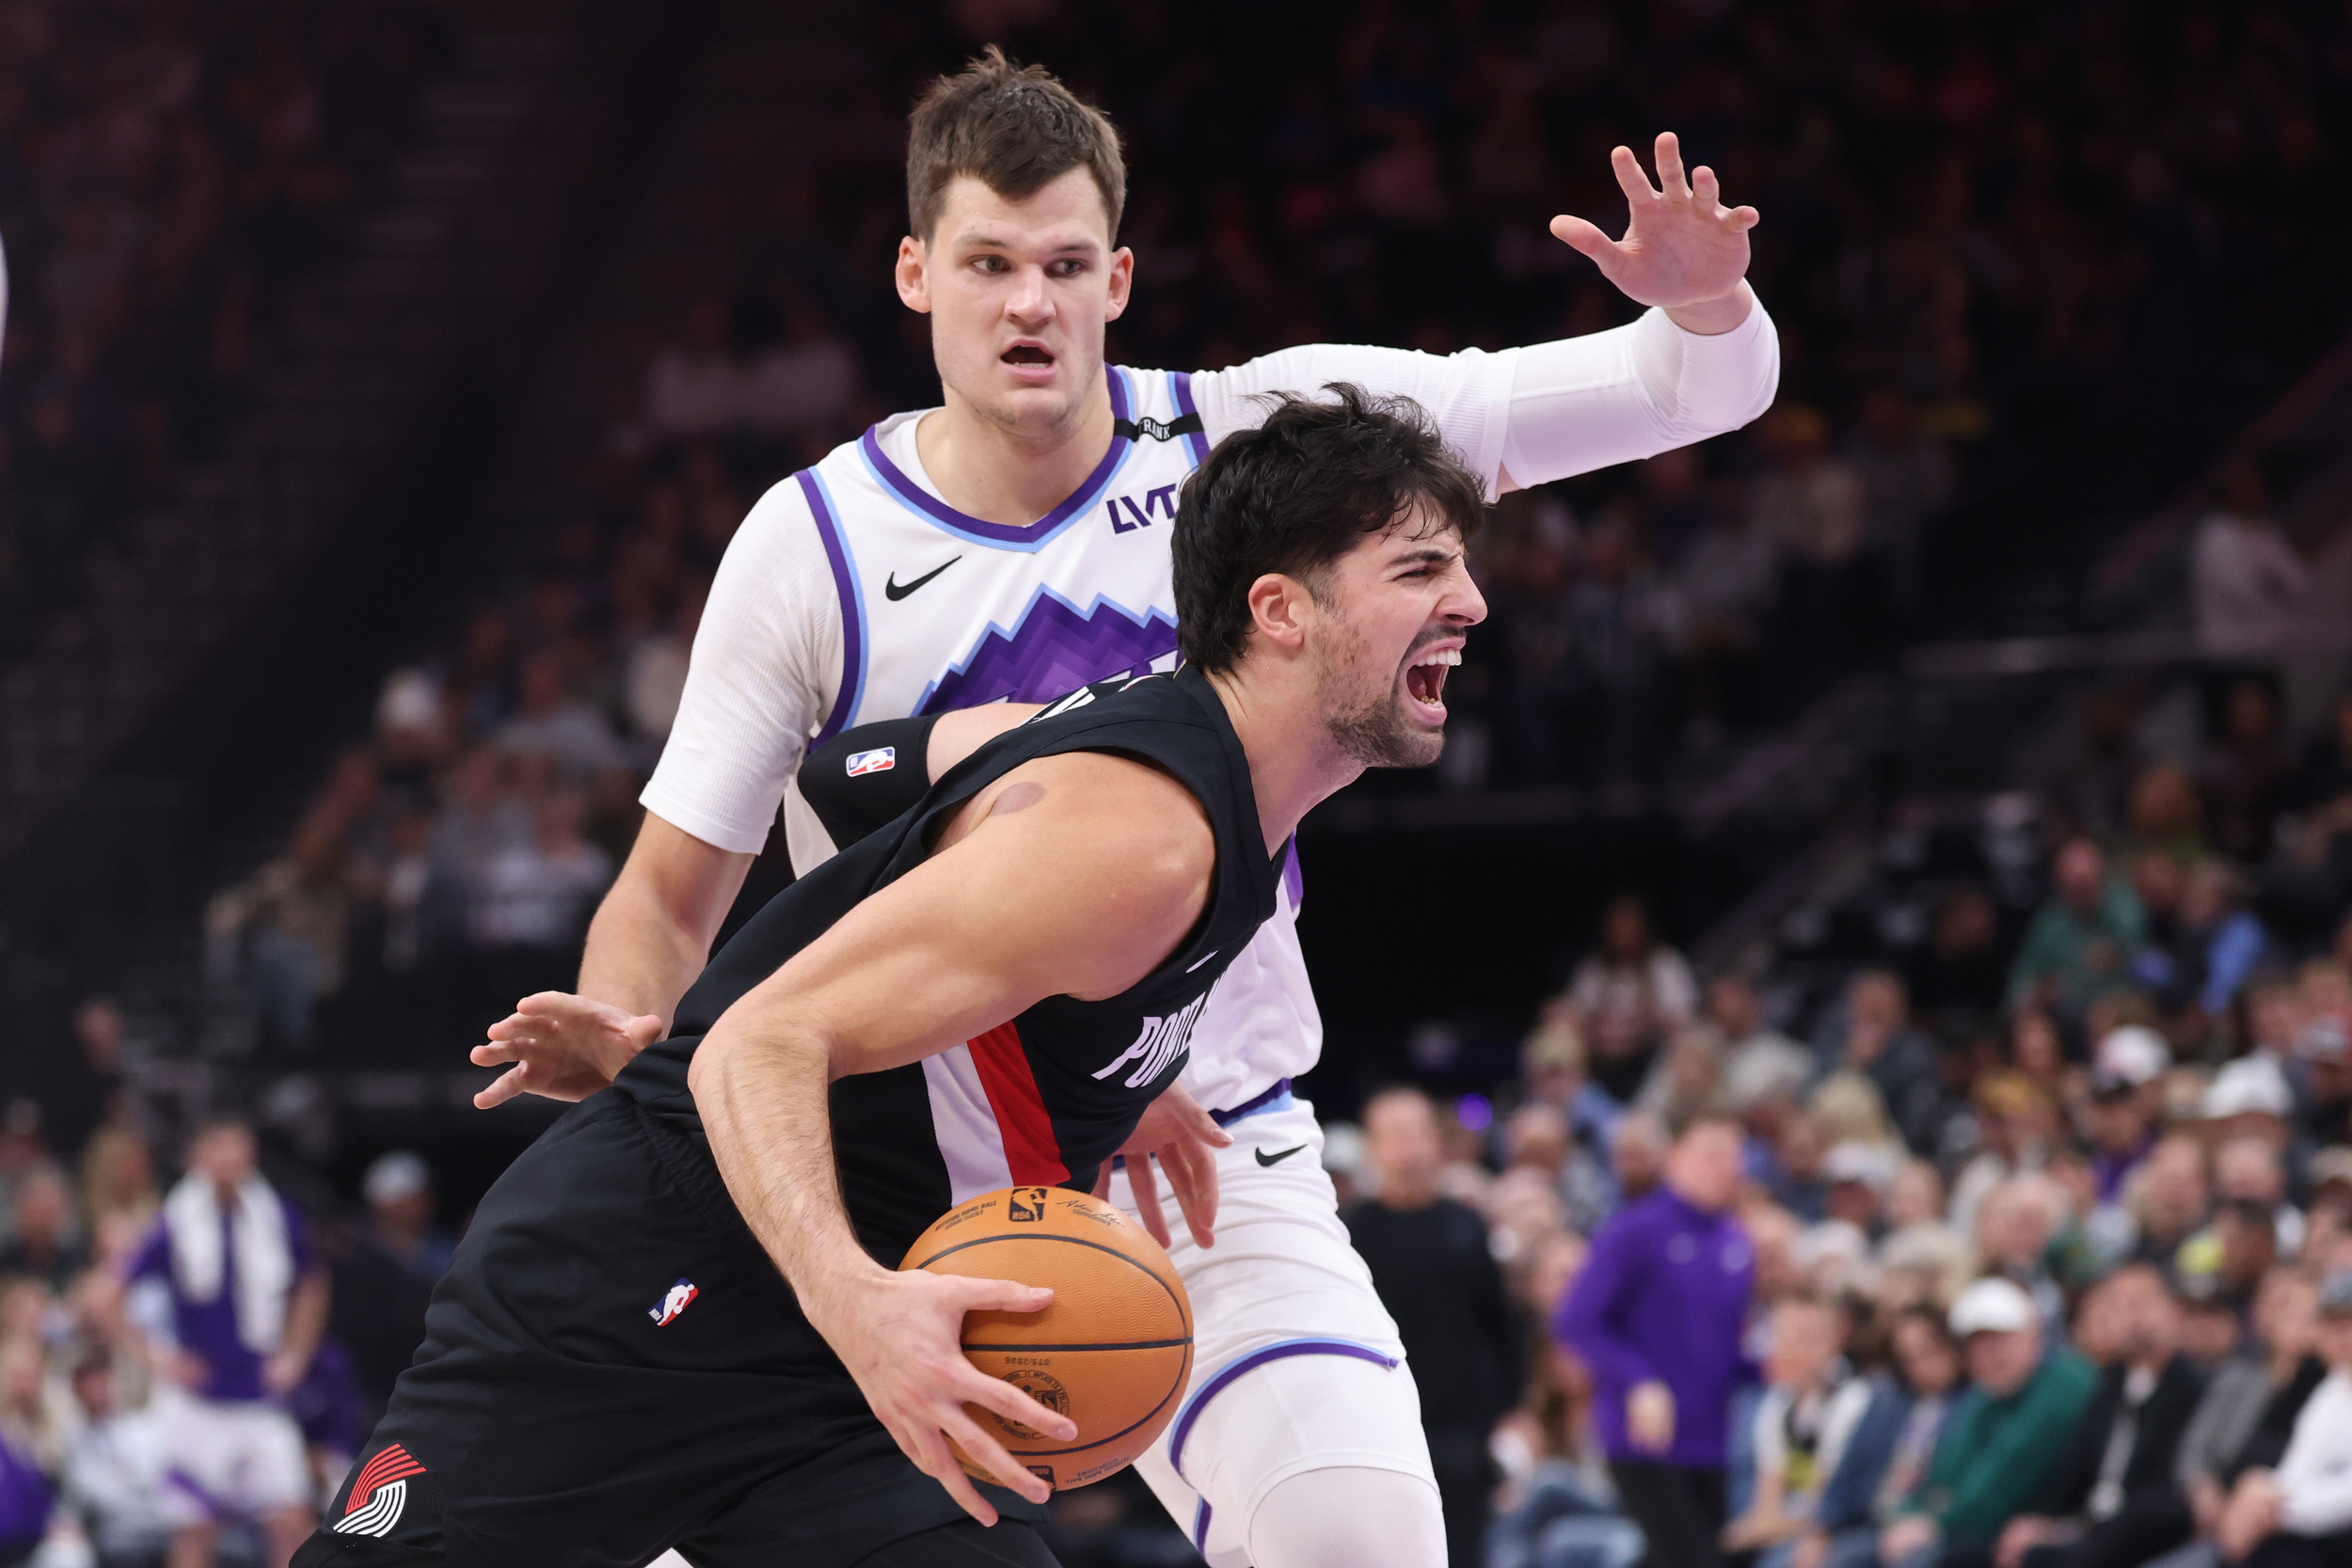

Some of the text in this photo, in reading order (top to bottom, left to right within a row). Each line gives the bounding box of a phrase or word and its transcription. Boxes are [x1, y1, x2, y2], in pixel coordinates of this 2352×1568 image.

[1106, 483, 1176, 534] LVT
[1090, 974, 1222, 1088] PORT
[648, 1308, 662, 1322] NBA
